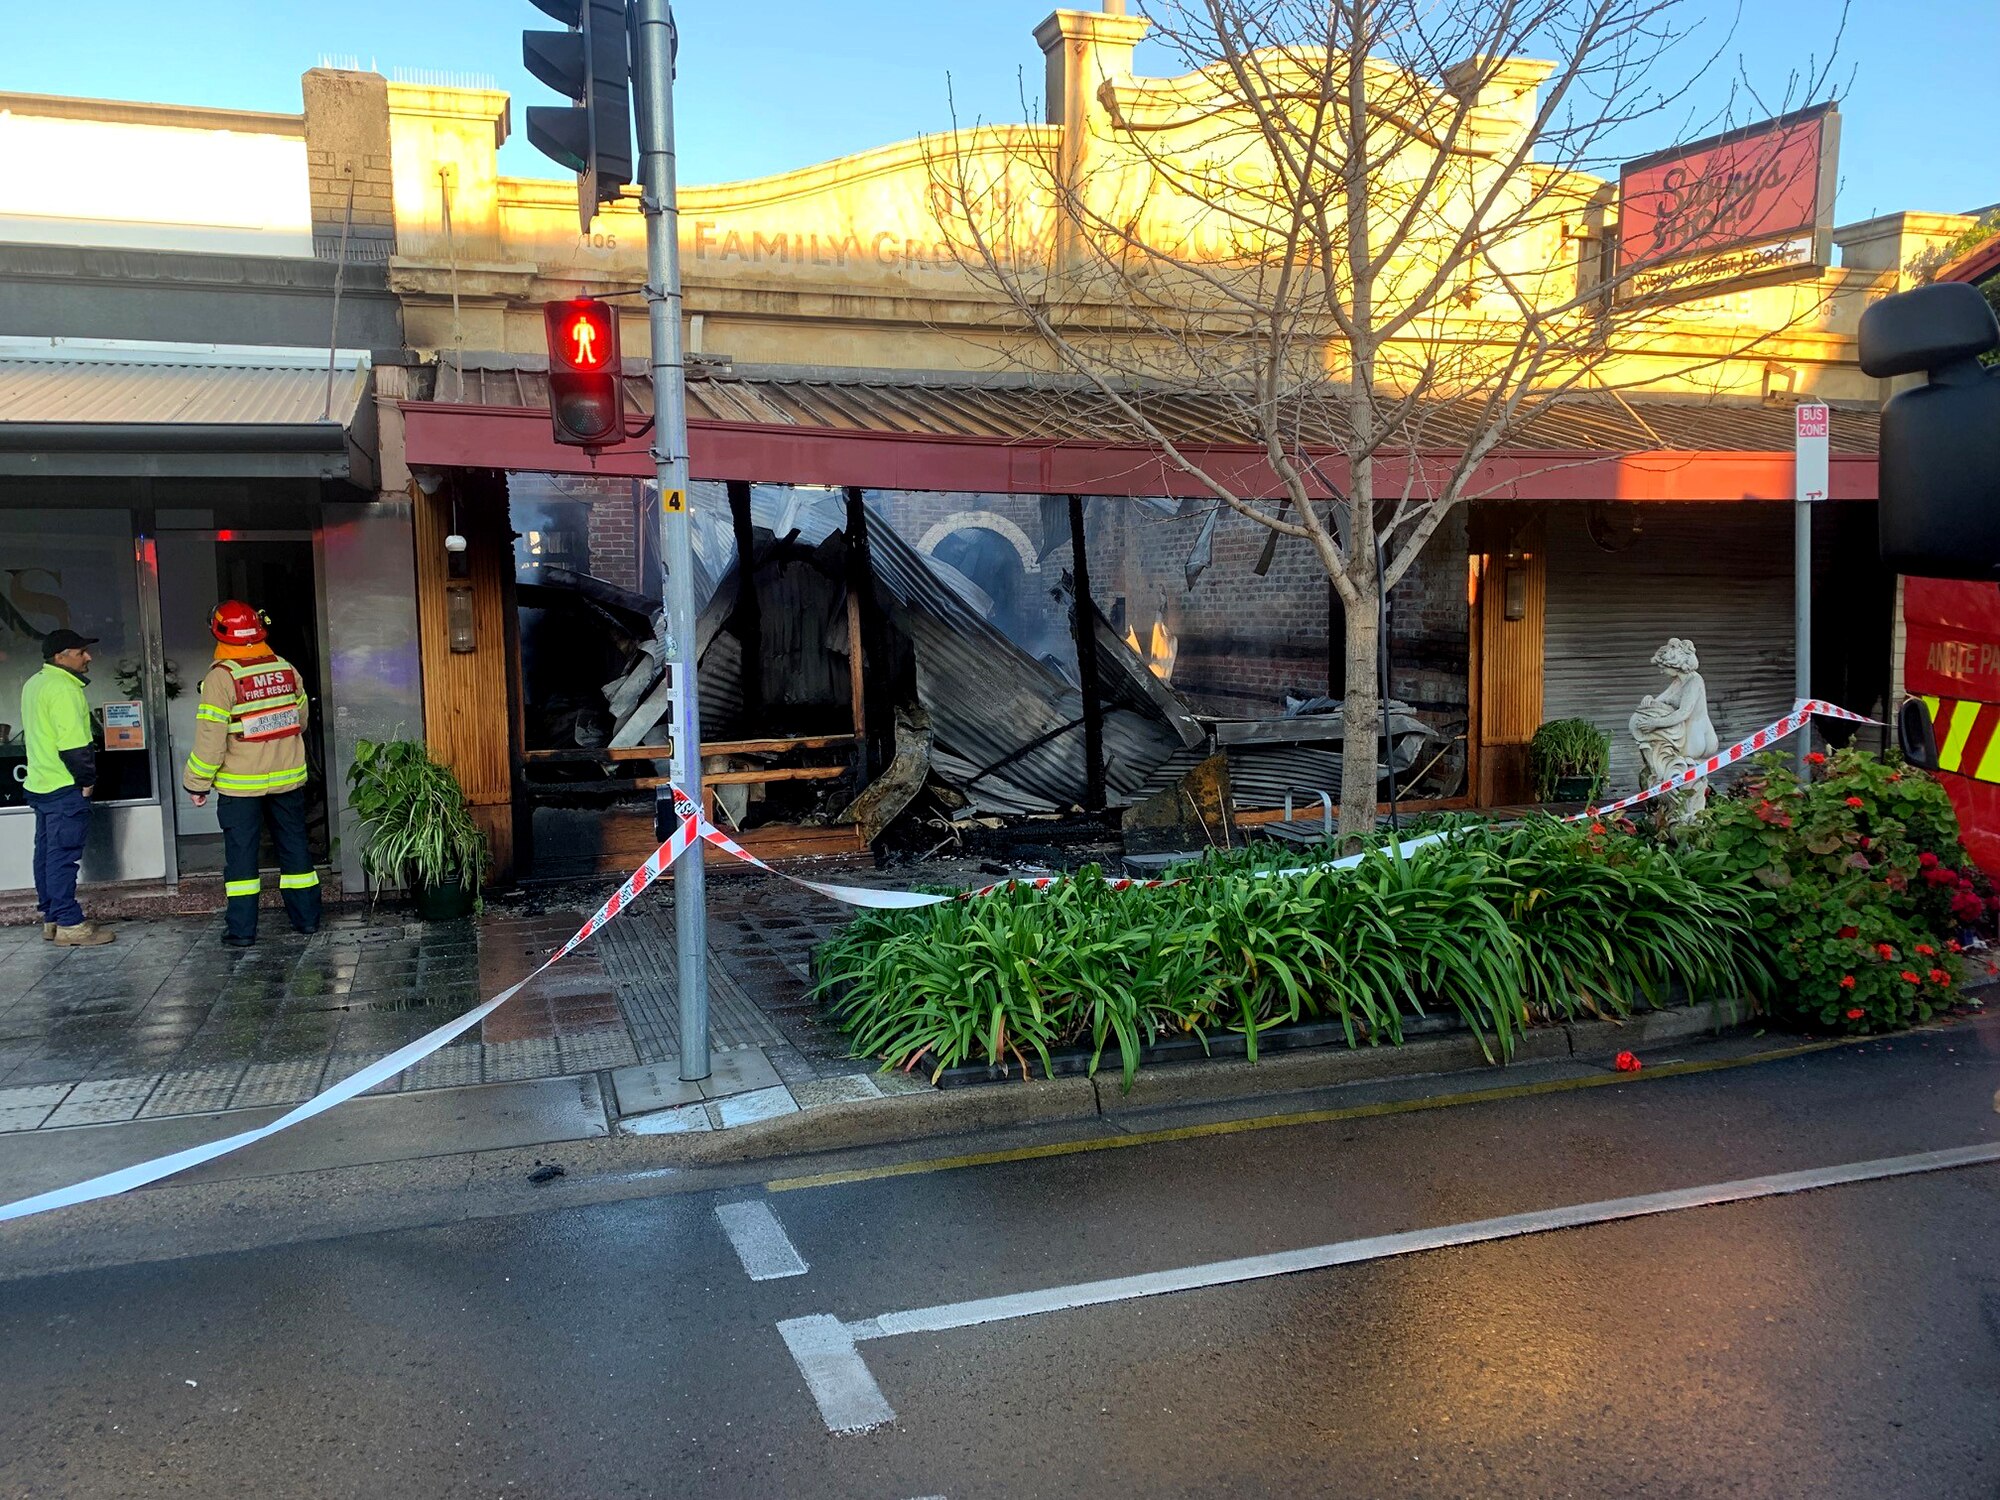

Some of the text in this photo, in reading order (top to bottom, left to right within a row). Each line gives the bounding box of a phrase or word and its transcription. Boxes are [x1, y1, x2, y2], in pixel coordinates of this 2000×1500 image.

[585, 233, 617, 249] 106
[695, 221, 853, 268] FAMILY
[1803, 409, 1823, 421] BUS
[1800, 424, 1826, 436] ZONE
[669, 491, 681, 511] 4
[1927, 641, 1975, 674] ANGLE
[253, 671, 285, 689] MFS
[245, 689, 265, 701] FIRE
